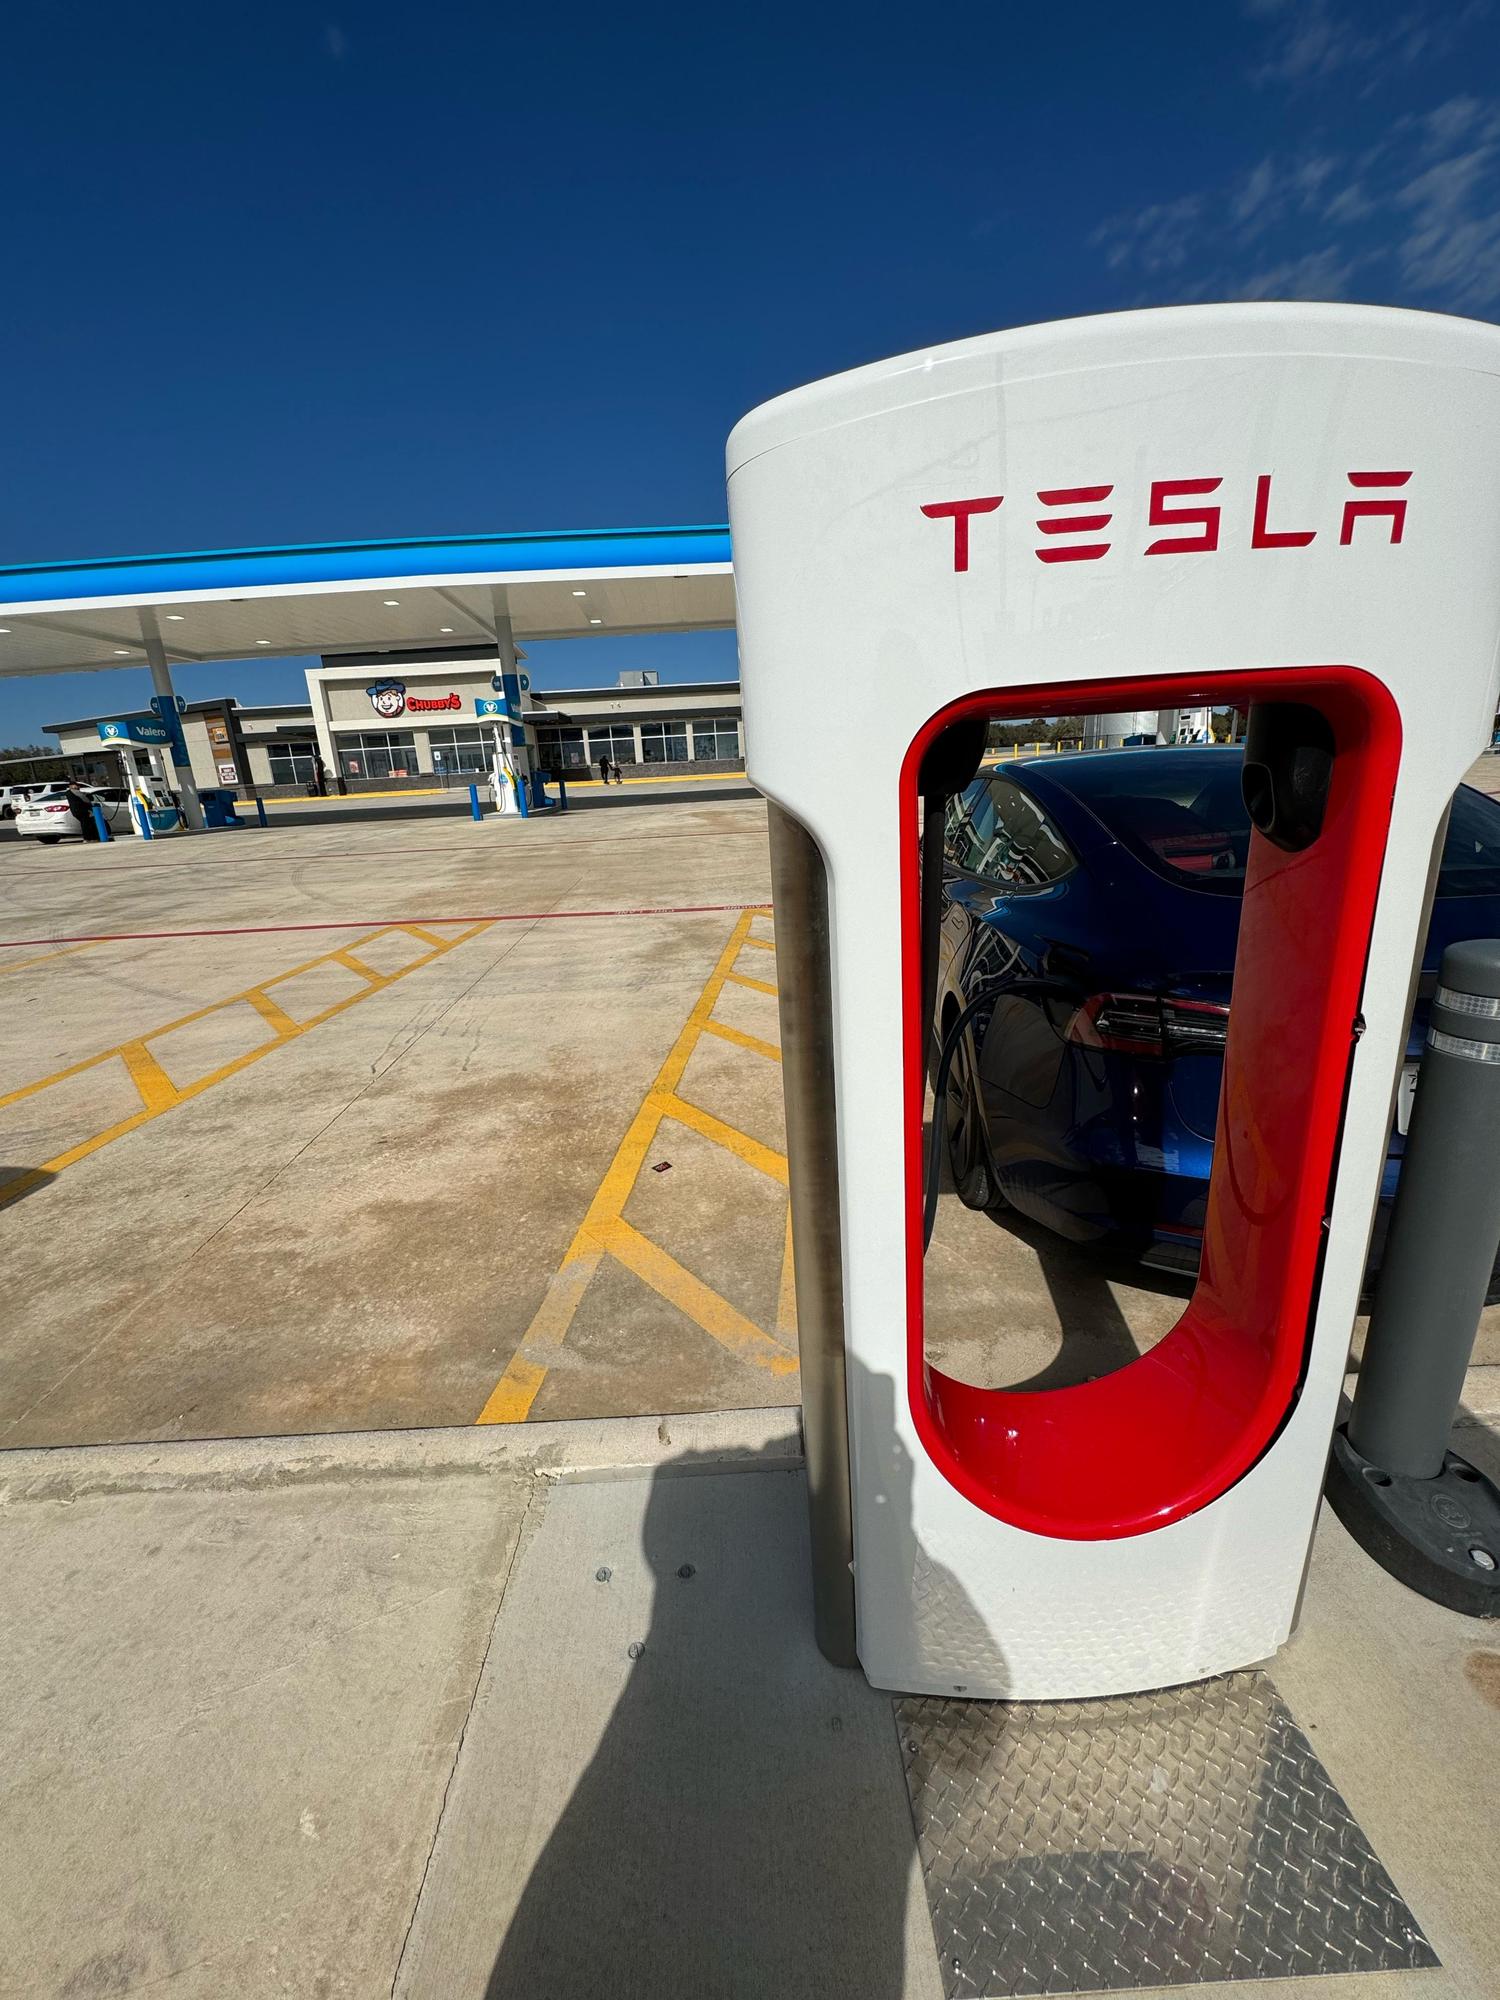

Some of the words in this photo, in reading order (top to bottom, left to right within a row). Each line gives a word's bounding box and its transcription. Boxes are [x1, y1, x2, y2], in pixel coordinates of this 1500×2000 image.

[920, 471, 1414, 573] TESLA
[407, 693, 461, 711] CHUBBY'S
[136, 726, 166, 737] Valero
